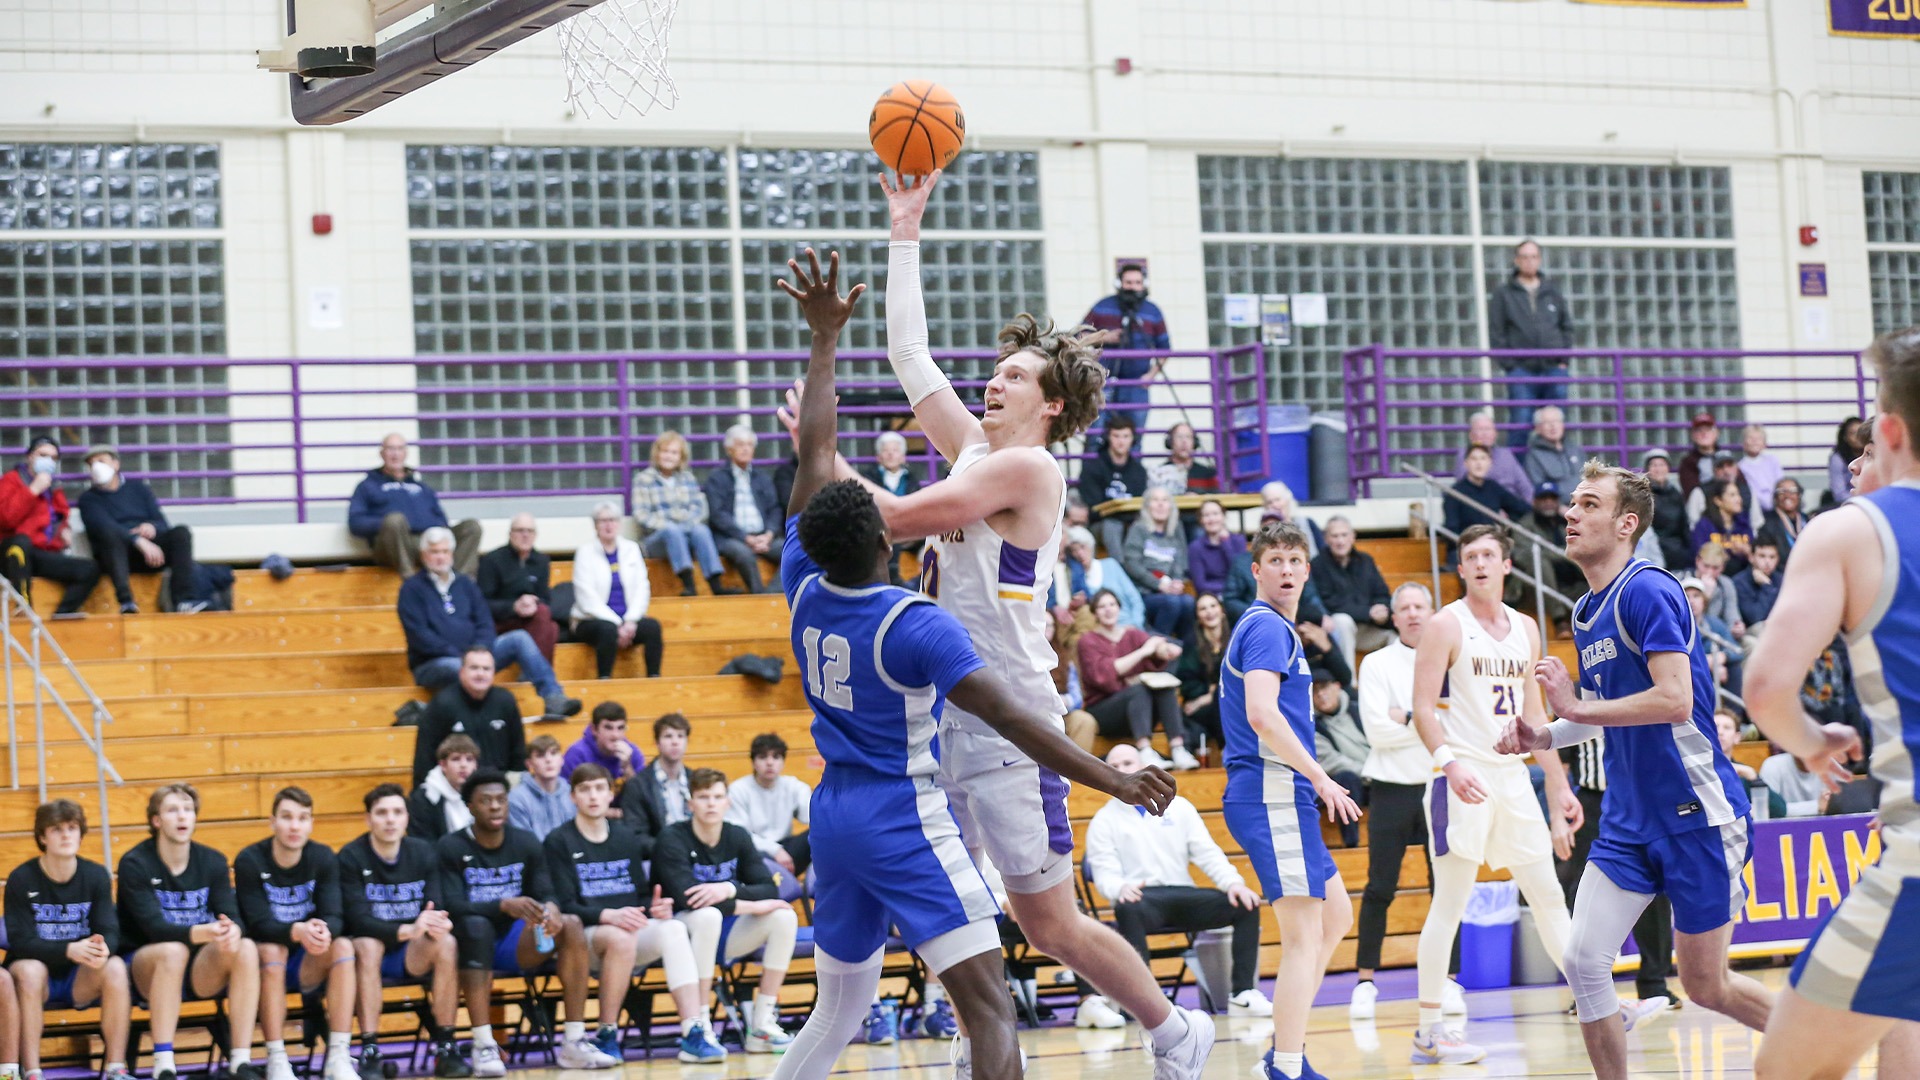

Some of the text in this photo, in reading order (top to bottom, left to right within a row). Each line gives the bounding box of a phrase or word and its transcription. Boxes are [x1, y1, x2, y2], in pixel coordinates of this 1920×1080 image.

[803, 626, 853, 712] 12
[1492, 684, 1516, 715] 21
[1733, 829, 1882, 924] LIAM
